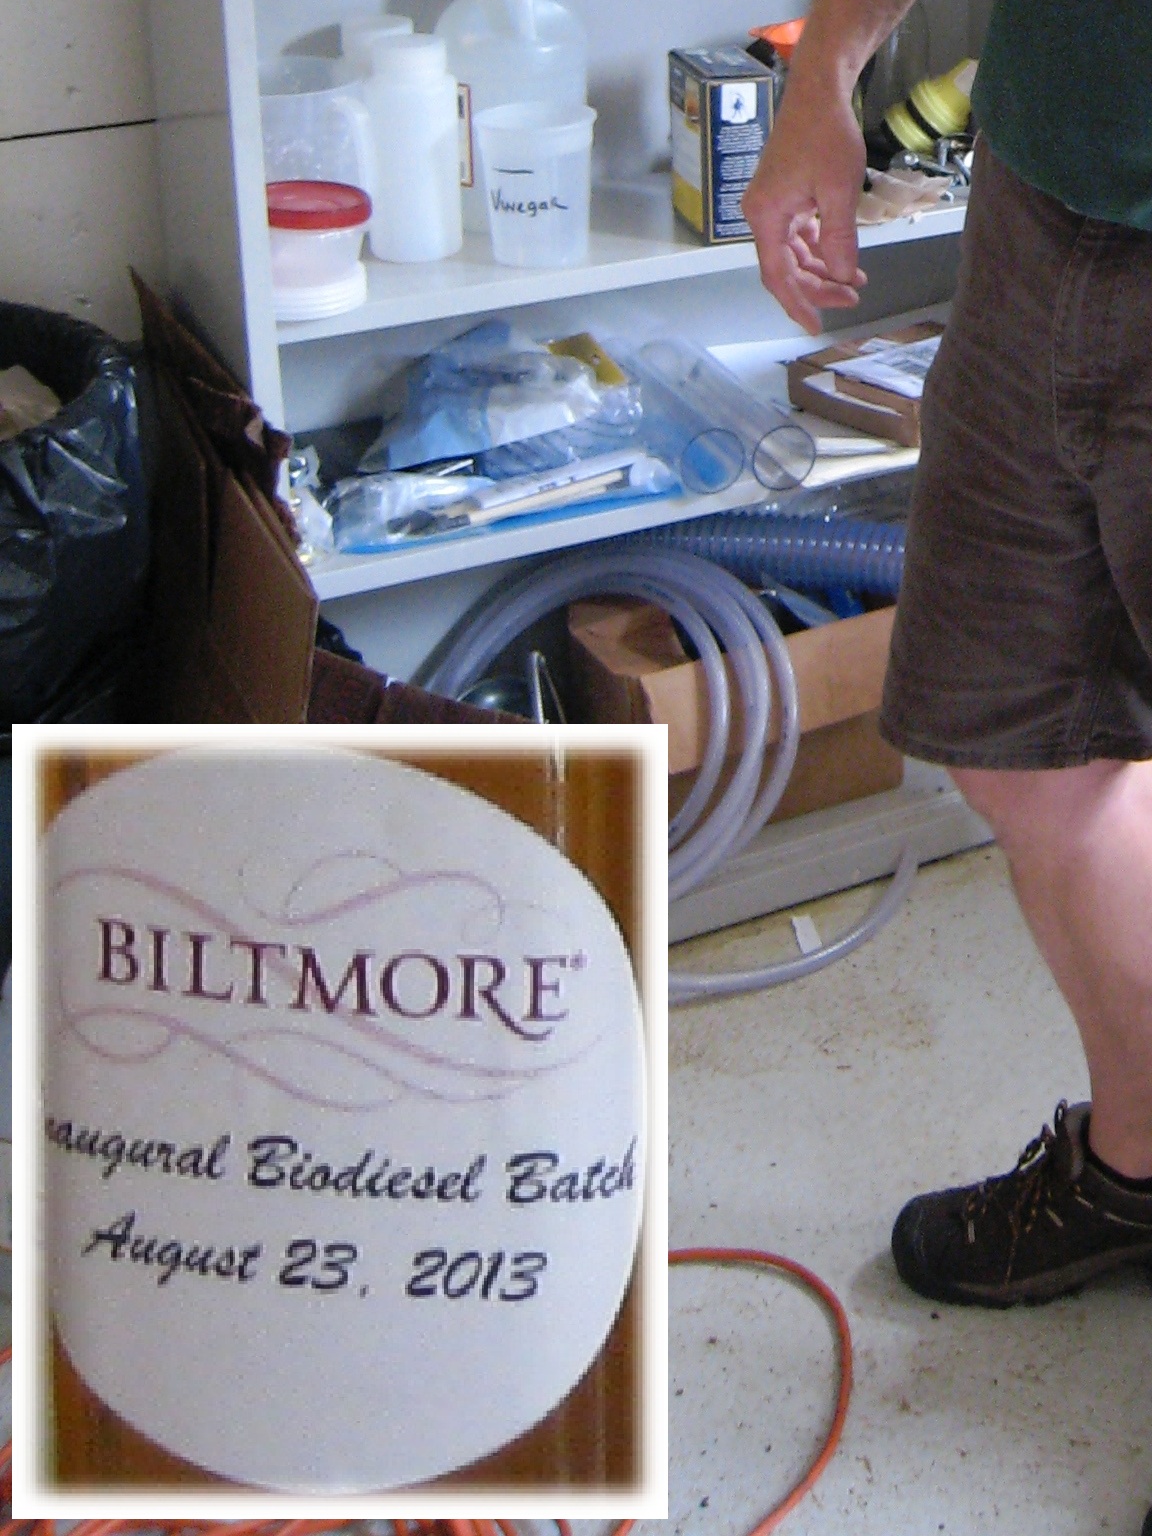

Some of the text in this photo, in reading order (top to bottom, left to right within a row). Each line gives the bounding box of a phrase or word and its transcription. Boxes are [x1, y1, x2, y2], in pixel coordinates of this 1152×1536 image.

[247, 1134, 488, 1203] Biodiesel
[505, 1135, 639, 1204] Batch
[80, 1209, 262, 1287] August
[405, 1246, 549, 1302] 2013
